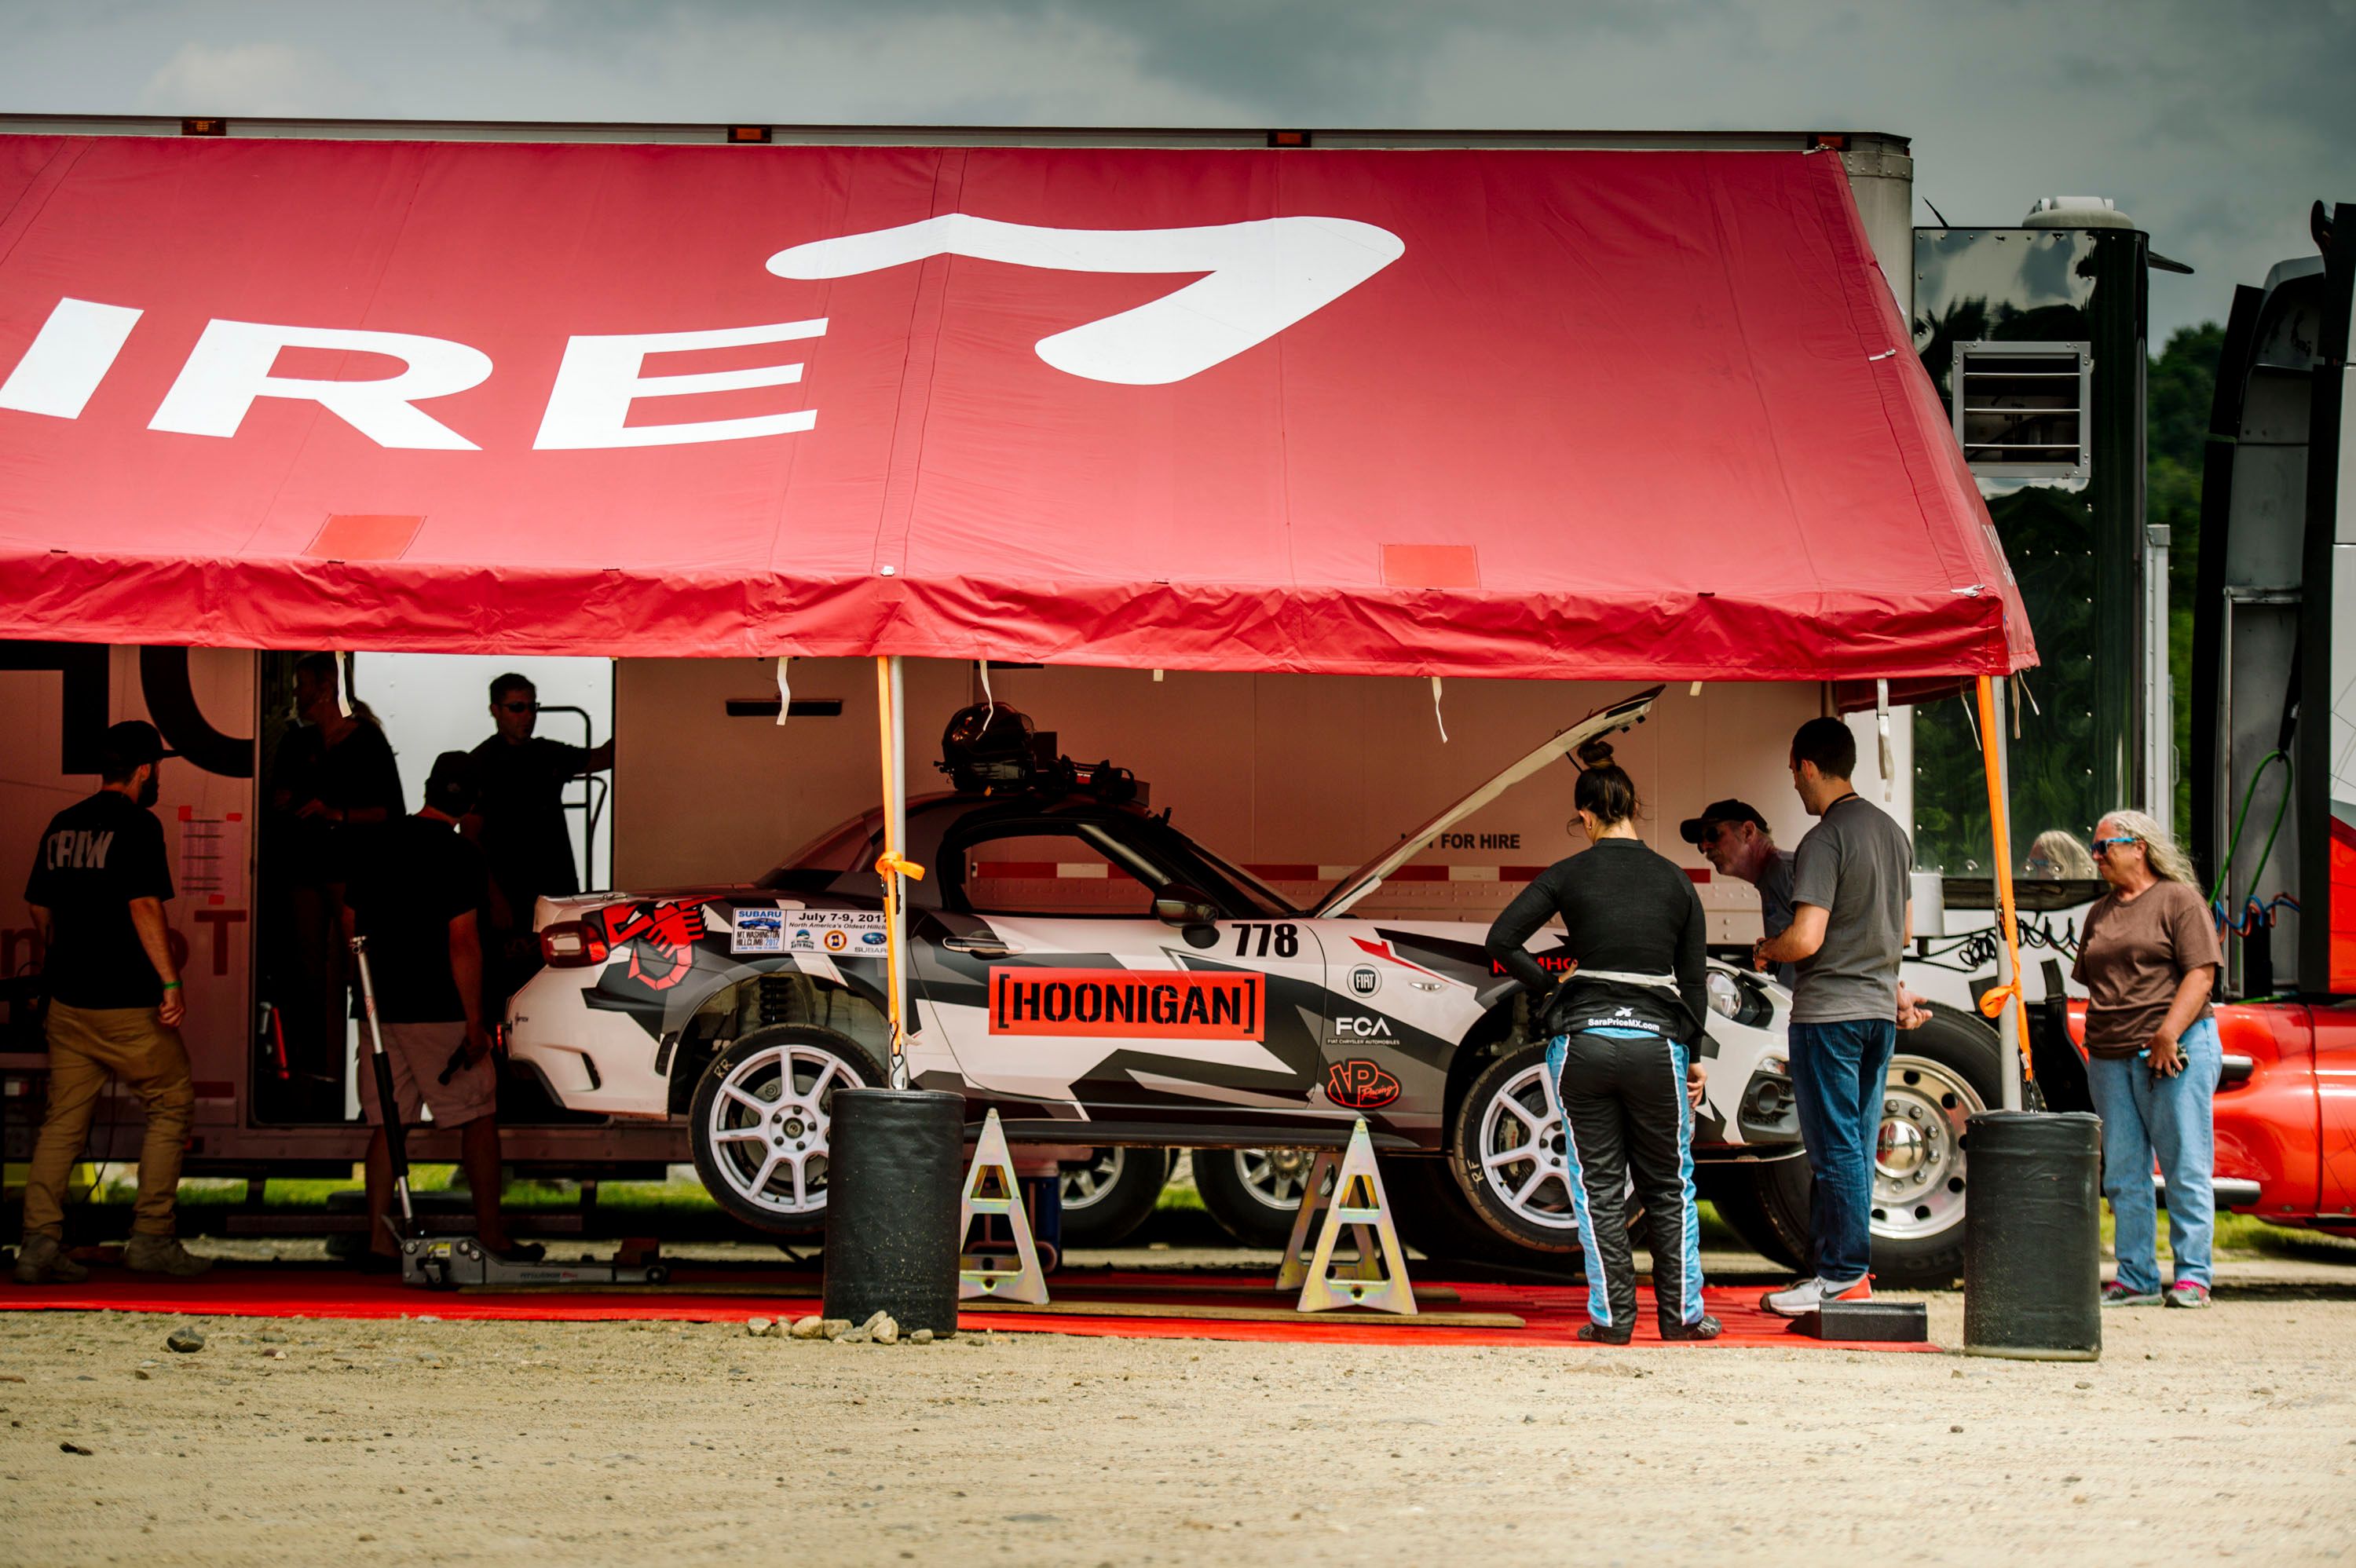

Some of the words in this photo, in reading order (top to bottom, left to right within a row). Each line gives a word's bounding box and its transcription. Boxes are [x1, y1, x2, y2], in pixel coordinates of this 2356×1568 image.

[1441, 833, 1475, 849] FOR
[1480, 834, 1520, 850] HIRE
[799, 912, 826, 923] July
[830, 913, 854, 923] 7-9,
[746, 930, 780, 939] WASHINGTON
[1231, 923, 1298, 958] 778
[1355, 974, 1374, 989] FIAT
[1336, 1017, 1392, 1036] FCA
[1588, 1018, 1659, 1032] SaraPriceMX.com
[714, 1059, 734, 1079] RR
[1330, 1061, 1379, 1106] VP
[1361, 1085, 1396, 1100] Racing
[1467, 1159, 1483, 1183] RF
